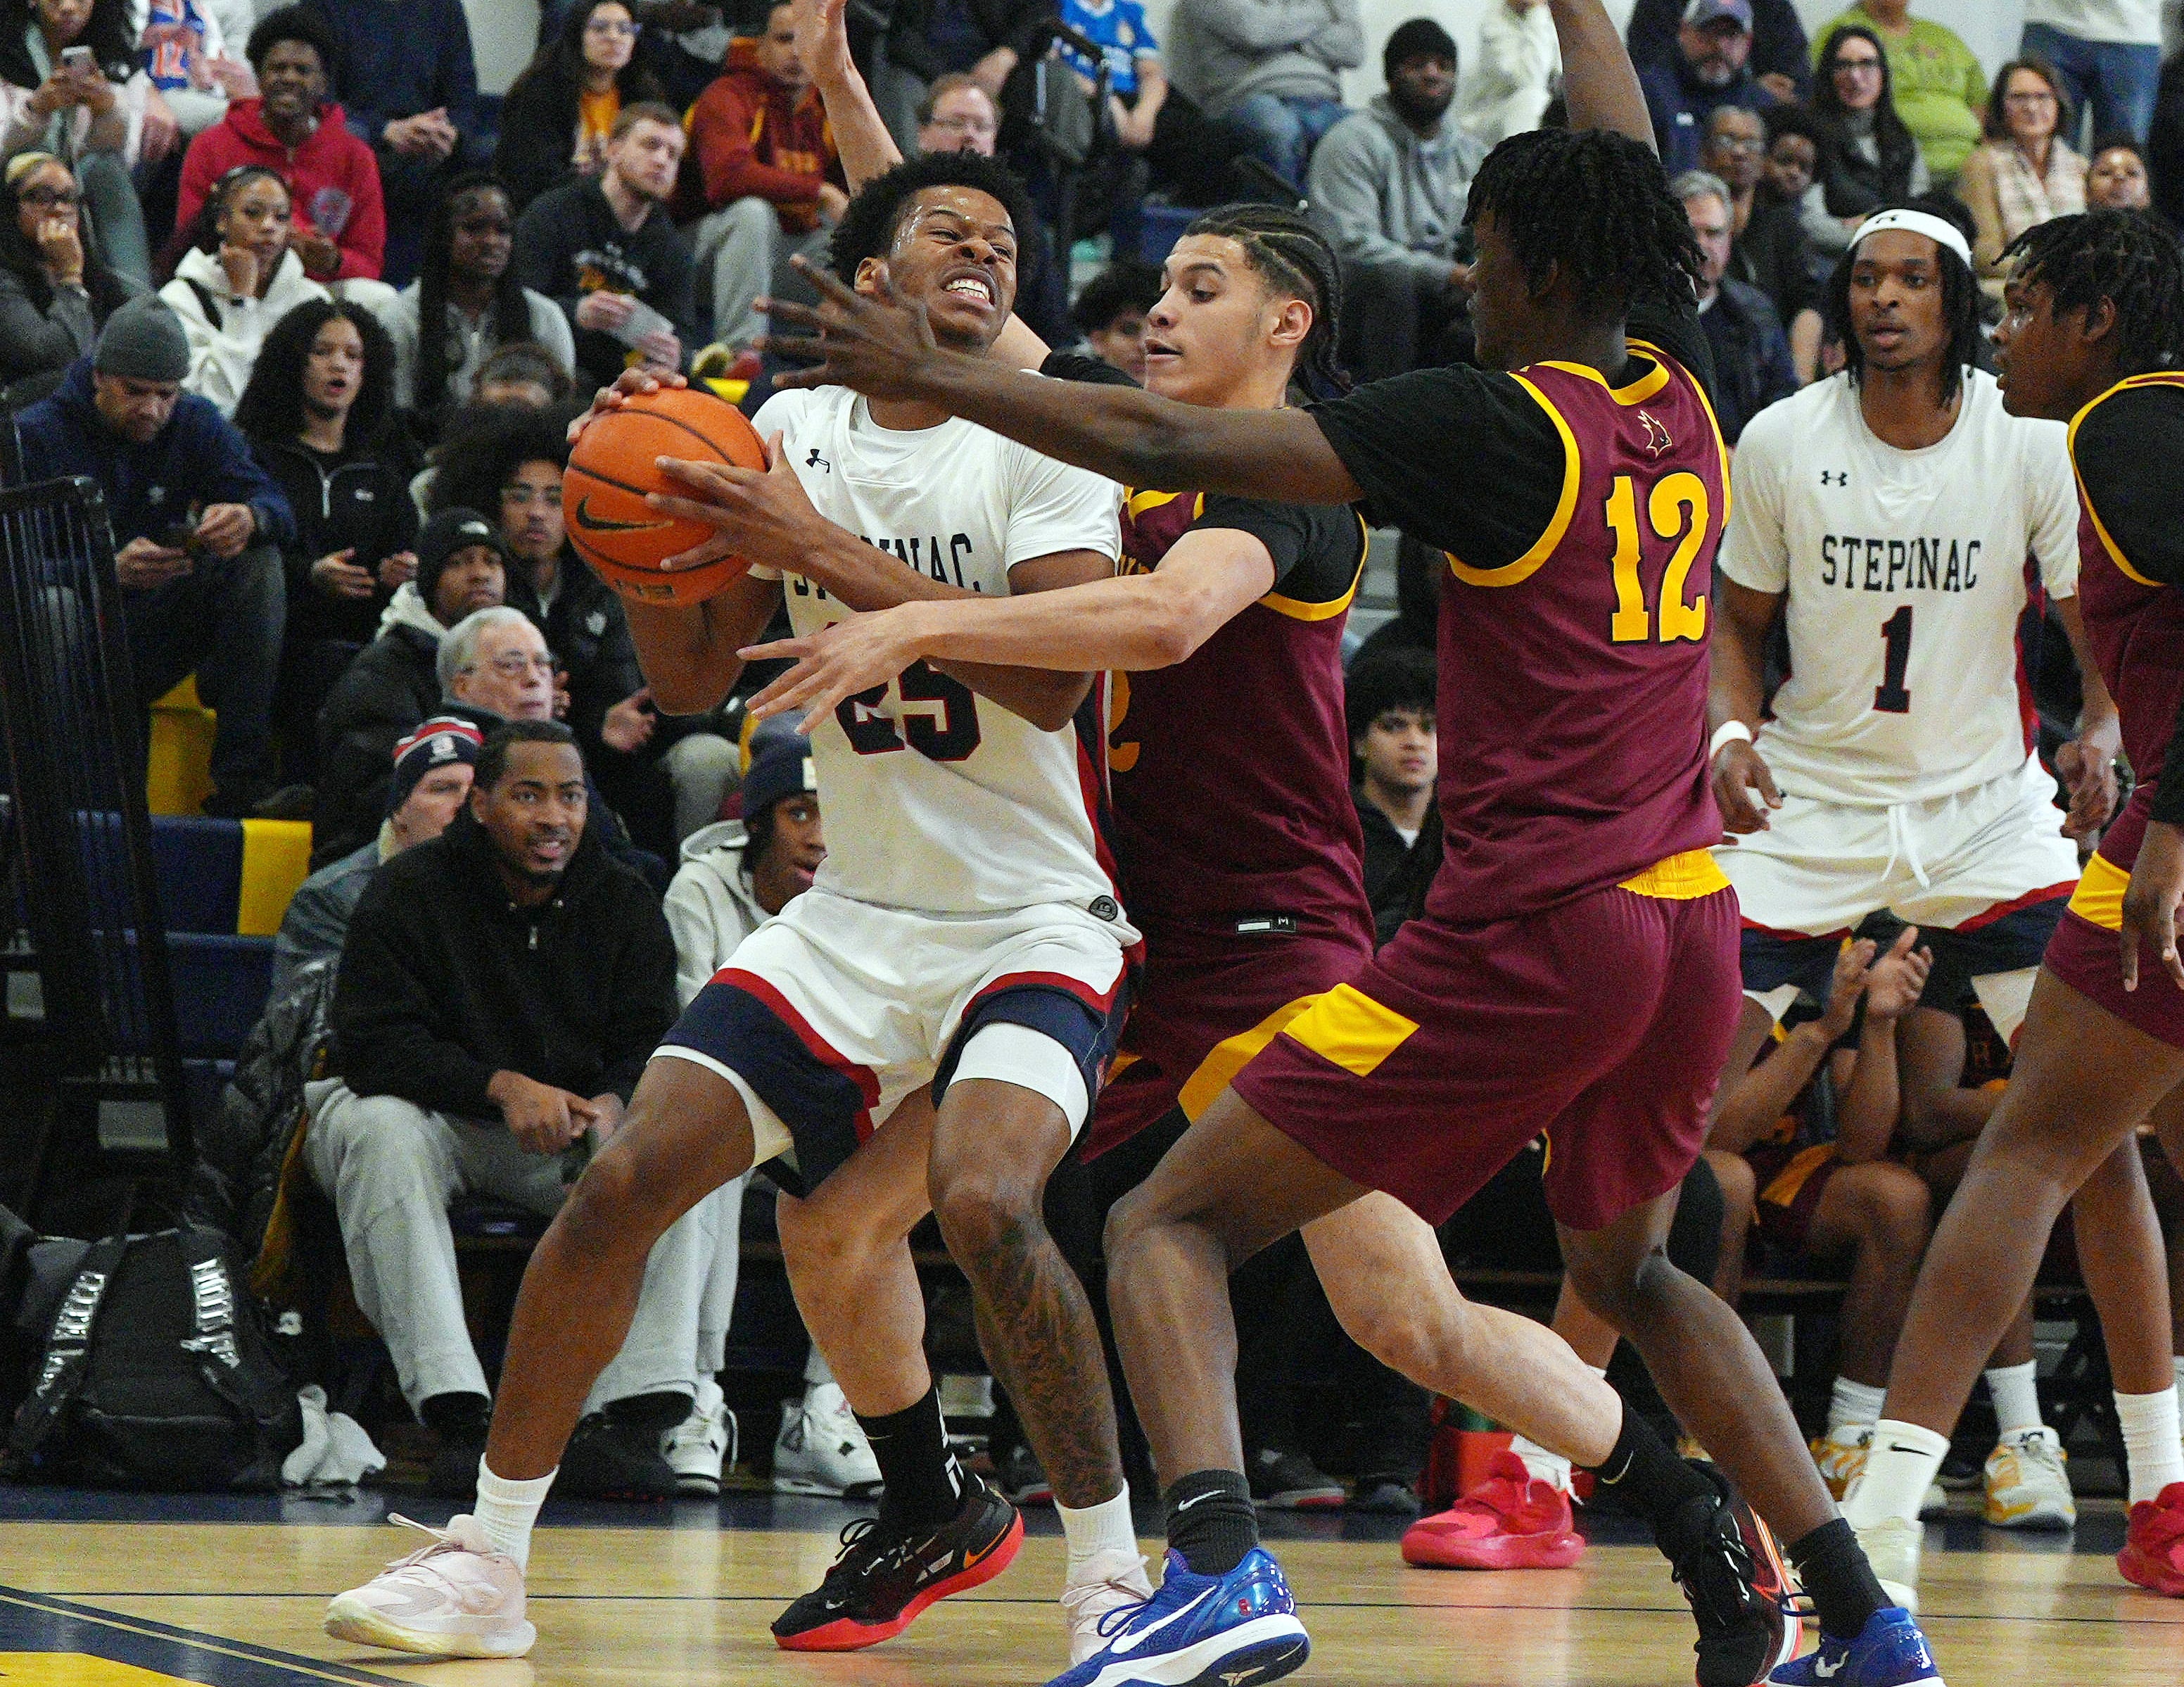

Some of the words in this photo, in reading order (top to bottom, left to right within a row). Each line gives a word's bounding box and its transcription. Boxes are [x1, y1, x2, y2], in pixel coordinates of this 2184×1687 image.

[1604, 471, 1710, 643] 12
[1822, 534, 1981, 592] STEPINAC
[1872, 604, 1913, 713] 1
